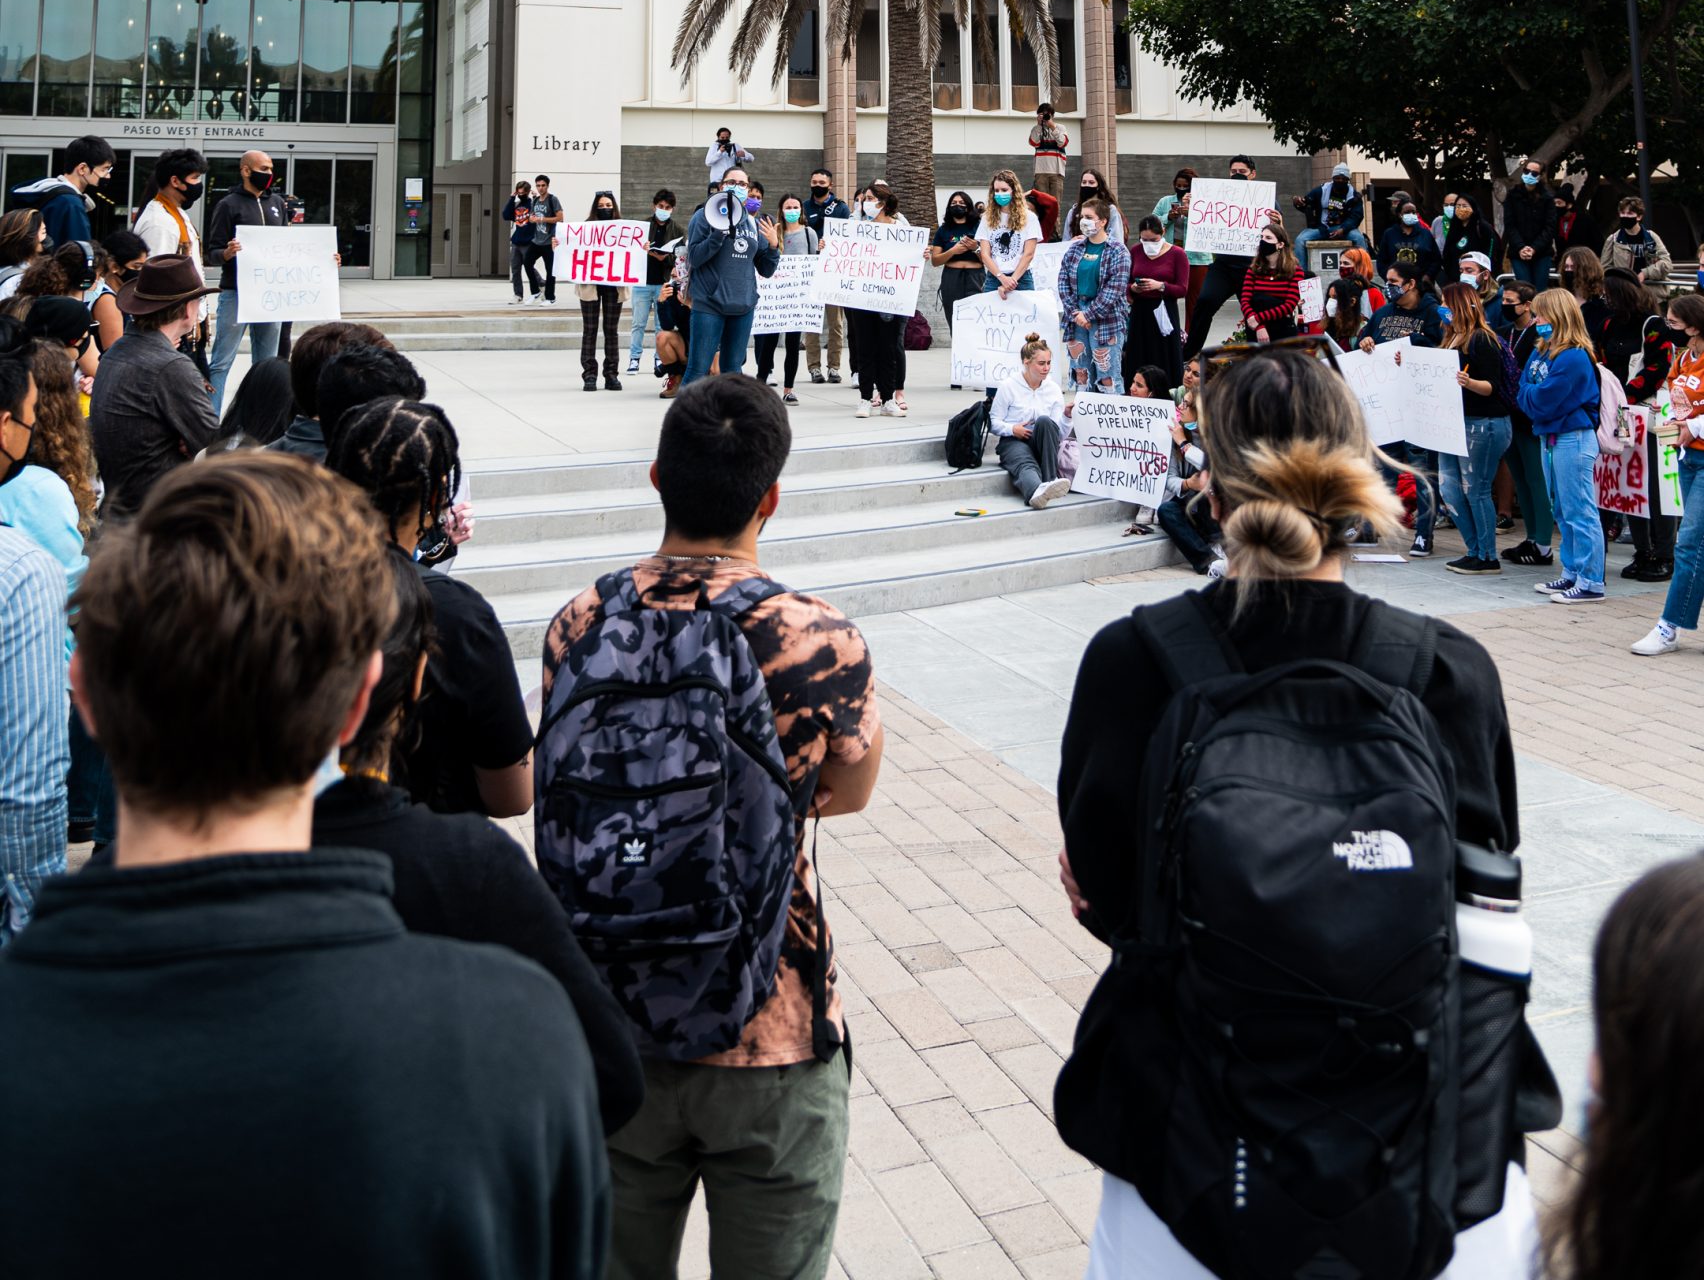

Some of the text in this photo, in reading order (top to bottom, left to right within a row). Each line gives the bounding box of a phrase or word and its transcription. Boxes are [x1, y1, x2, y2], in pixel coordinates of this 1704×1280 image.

[123, 125, 265, 137] PASEO WEST ENTRANCE
[532, 135, 601, 156] Library
[1242, 183, 1275, 207] NOT
[566, 224, 644, 248] MUNGER
[829, 221, 925, 244] WE ARE NOT A
[829, 240, 881, 258] SOCIAL
[254, 265, 321, 285] FUCKING
[571, 249, 639, 283] HELL
[823, 258, 920, 282] EXPERIMENT
[775, 281, 799, 290] WOULD
[840, 279, 896, 296] WE DEMAND
[1299, 277, 1320, 293] EAT
[955, 302, 1038, 325] Extend
[985, 325, 1016, 351] my
[953, 352, 987, 381] hotel
[1345, 356, 1400, 388] MPOS
[1078, 401, 1120, 416] SCHOOL
[1130, 404, 1169, 420] PRISON
[1361, 392, 1383, 410] HE
[1097, 417, 1152, 433] PIPELINE?
[1088, 436, 1158, 463] STANFORD
[1139, 455, 1169, 477] UCSB
[1088, 467, 1158, 495] EXPERIMENT
[1593, 465, 1621, 490] MAN
[1351, 830, 1381, 843] THE
[622, 854, 646, 863] adidas
[1332, 841, 1382, 857] NORTH
[1347, 855, 1384, 870] FACE
